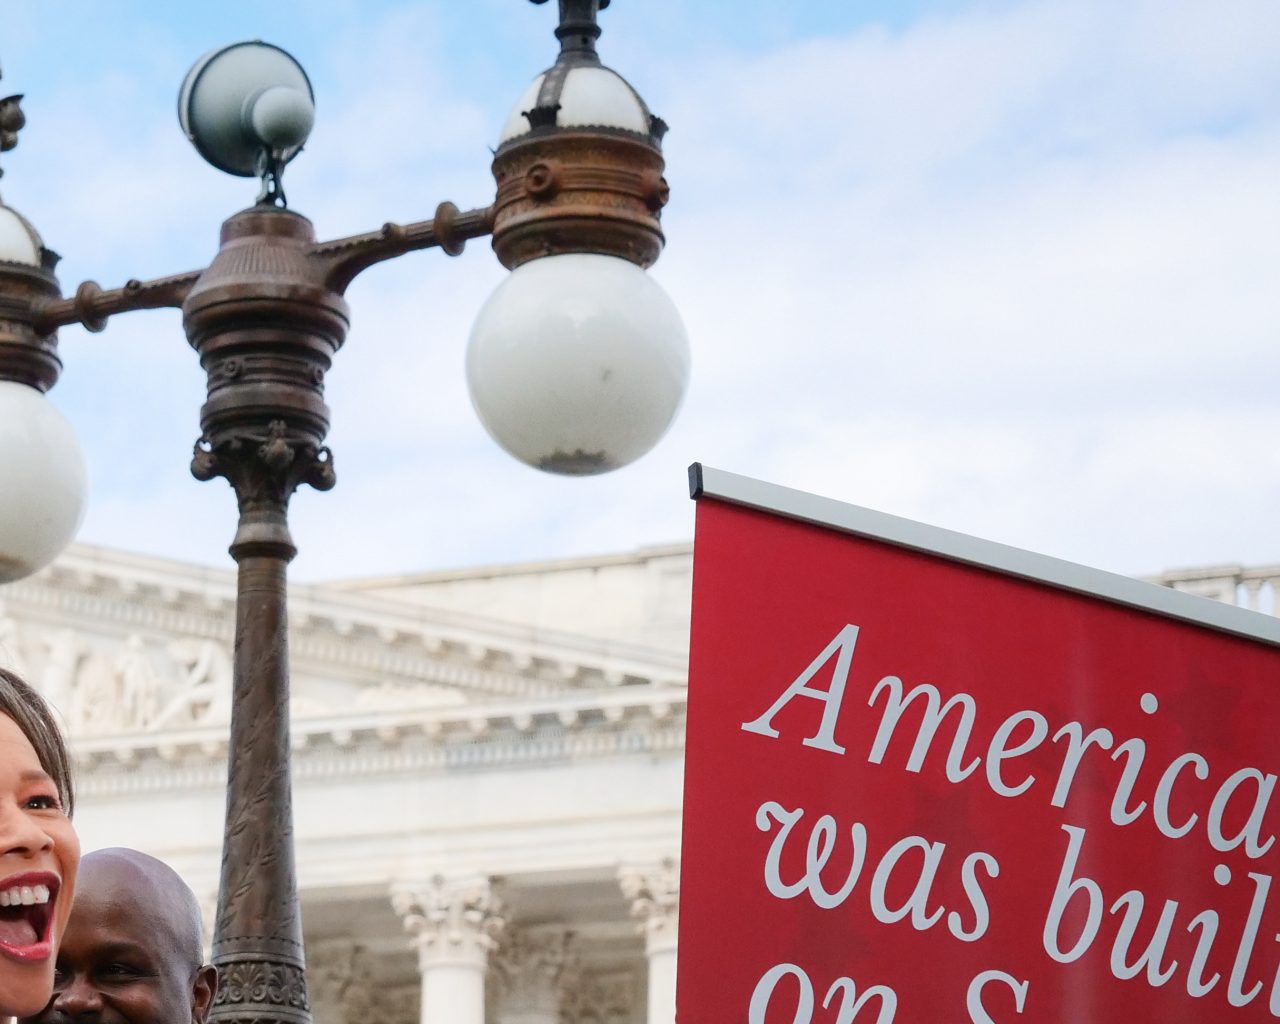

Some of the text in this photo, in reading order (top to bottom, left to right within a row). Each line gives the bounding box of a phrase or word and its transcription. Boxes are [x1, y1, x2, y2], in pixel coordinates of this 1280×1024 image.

[741, 624, 1277, 858] America
[756, 801, 1280, 1017] was buil
